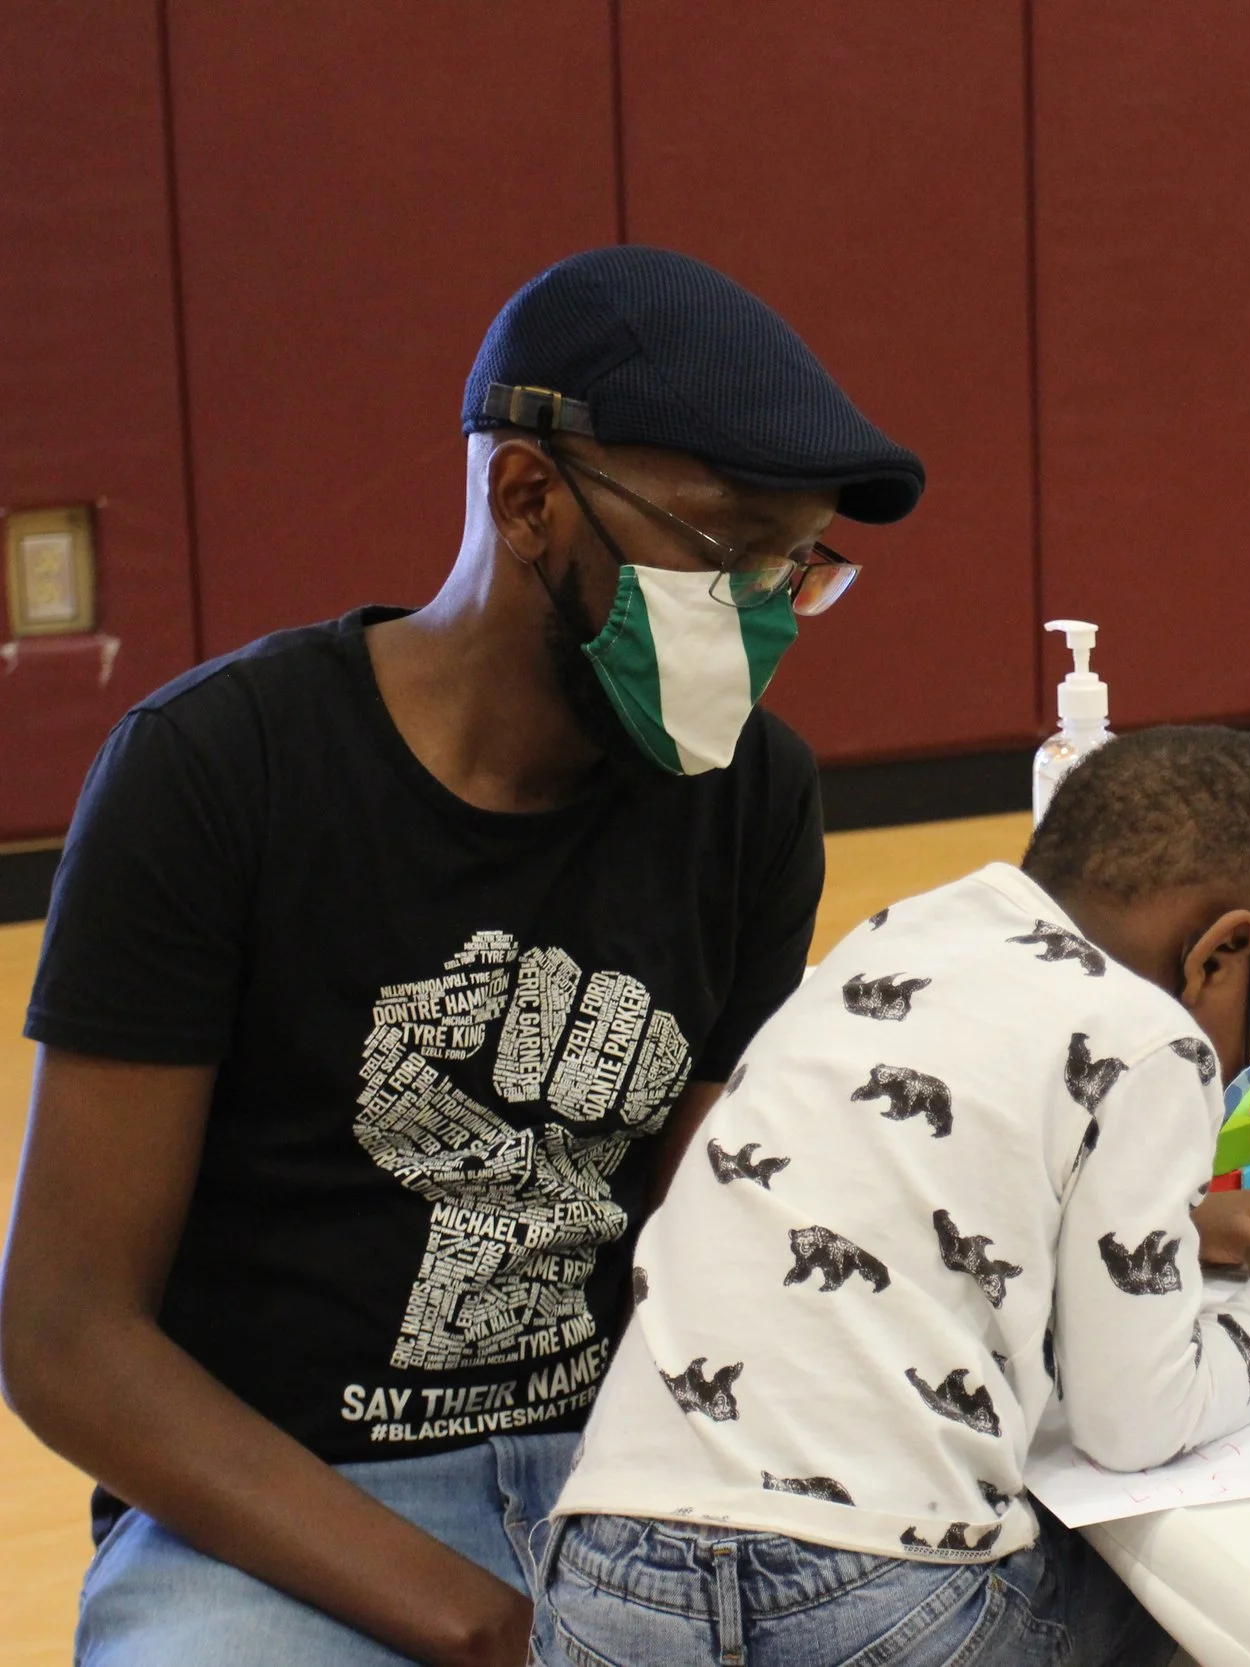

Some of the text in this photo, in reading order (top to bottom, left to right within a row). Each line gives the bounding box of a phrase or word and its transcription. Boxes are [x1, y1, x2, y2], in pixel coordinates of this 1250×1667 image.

[470, 971, 490, 984] TYRE
[480, 950, 505, 964] TYRE
[372, 999, 443, 1026] DONTRE
[518, 967, 541, 1086] ERIC GARNER
[562, 1020, 596, 1064] EZELL
[579, 973, 609, 1017] FORD
[358, 1052, 386, 1080] EZELL
[378, 1027, 403, 1054] FORD
[402, 1022, 448, 1048] TYRE
[452, 1022, 486, 1049] KING
[421, 1046, 467, 1061] EZELL FORD
[582, 984, 646, 1118] DANTE PARKER
[649, 1019, 672, 1081] ERIC HARRIS
[355, 1090, 398, 1126] EZELL
[389, 1052, 427, 1092] FORD
[356, 1074, 388, 1106] WALTER
[381, 1043, 407, 1073] SCOTT
[411, 1065, 440, 1094] ERIC
[413, 1105, 470, 1150] WALTER
[433, 1168, 494, 1182] SANDRA BLAND
[430, 1202, 518, 1244] MICHAEL
[475, 1202, 502, 1214] SCOTT
[455, 1240, 506, 1328] ERIC HARRIS
[390, 1281, 431, 1370] ERIC HARRIS
[464, 1309, 519, 1343] MYA HALL
[518, 1311, 596, 1361] TYRE KING
[341, 1384, 412, 1422] SAY
[422, 1380, 517, 1419] THEIR
[371, 1386, 597, 1441] #BLACKLIVESMATTER
